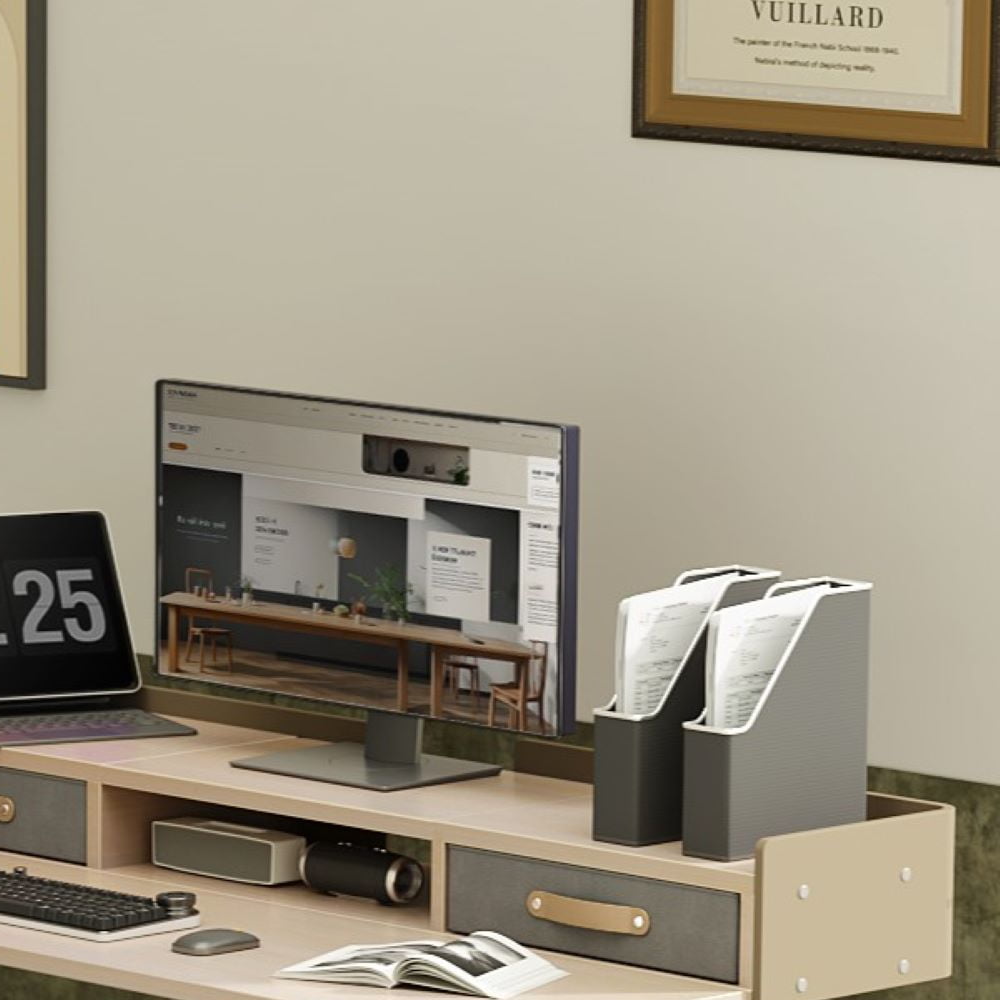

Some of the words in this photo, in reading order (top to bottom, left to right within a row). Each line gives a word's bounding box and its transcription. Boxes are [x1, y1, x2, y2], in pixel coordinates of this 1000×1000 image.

[751, 0, 884, 28] VUILLARD
[733, 36, 746, 45] The
[782, 40, 793, 48] the
[810, 60, 818, 68] of
[12, 568, 106, 645] 25
